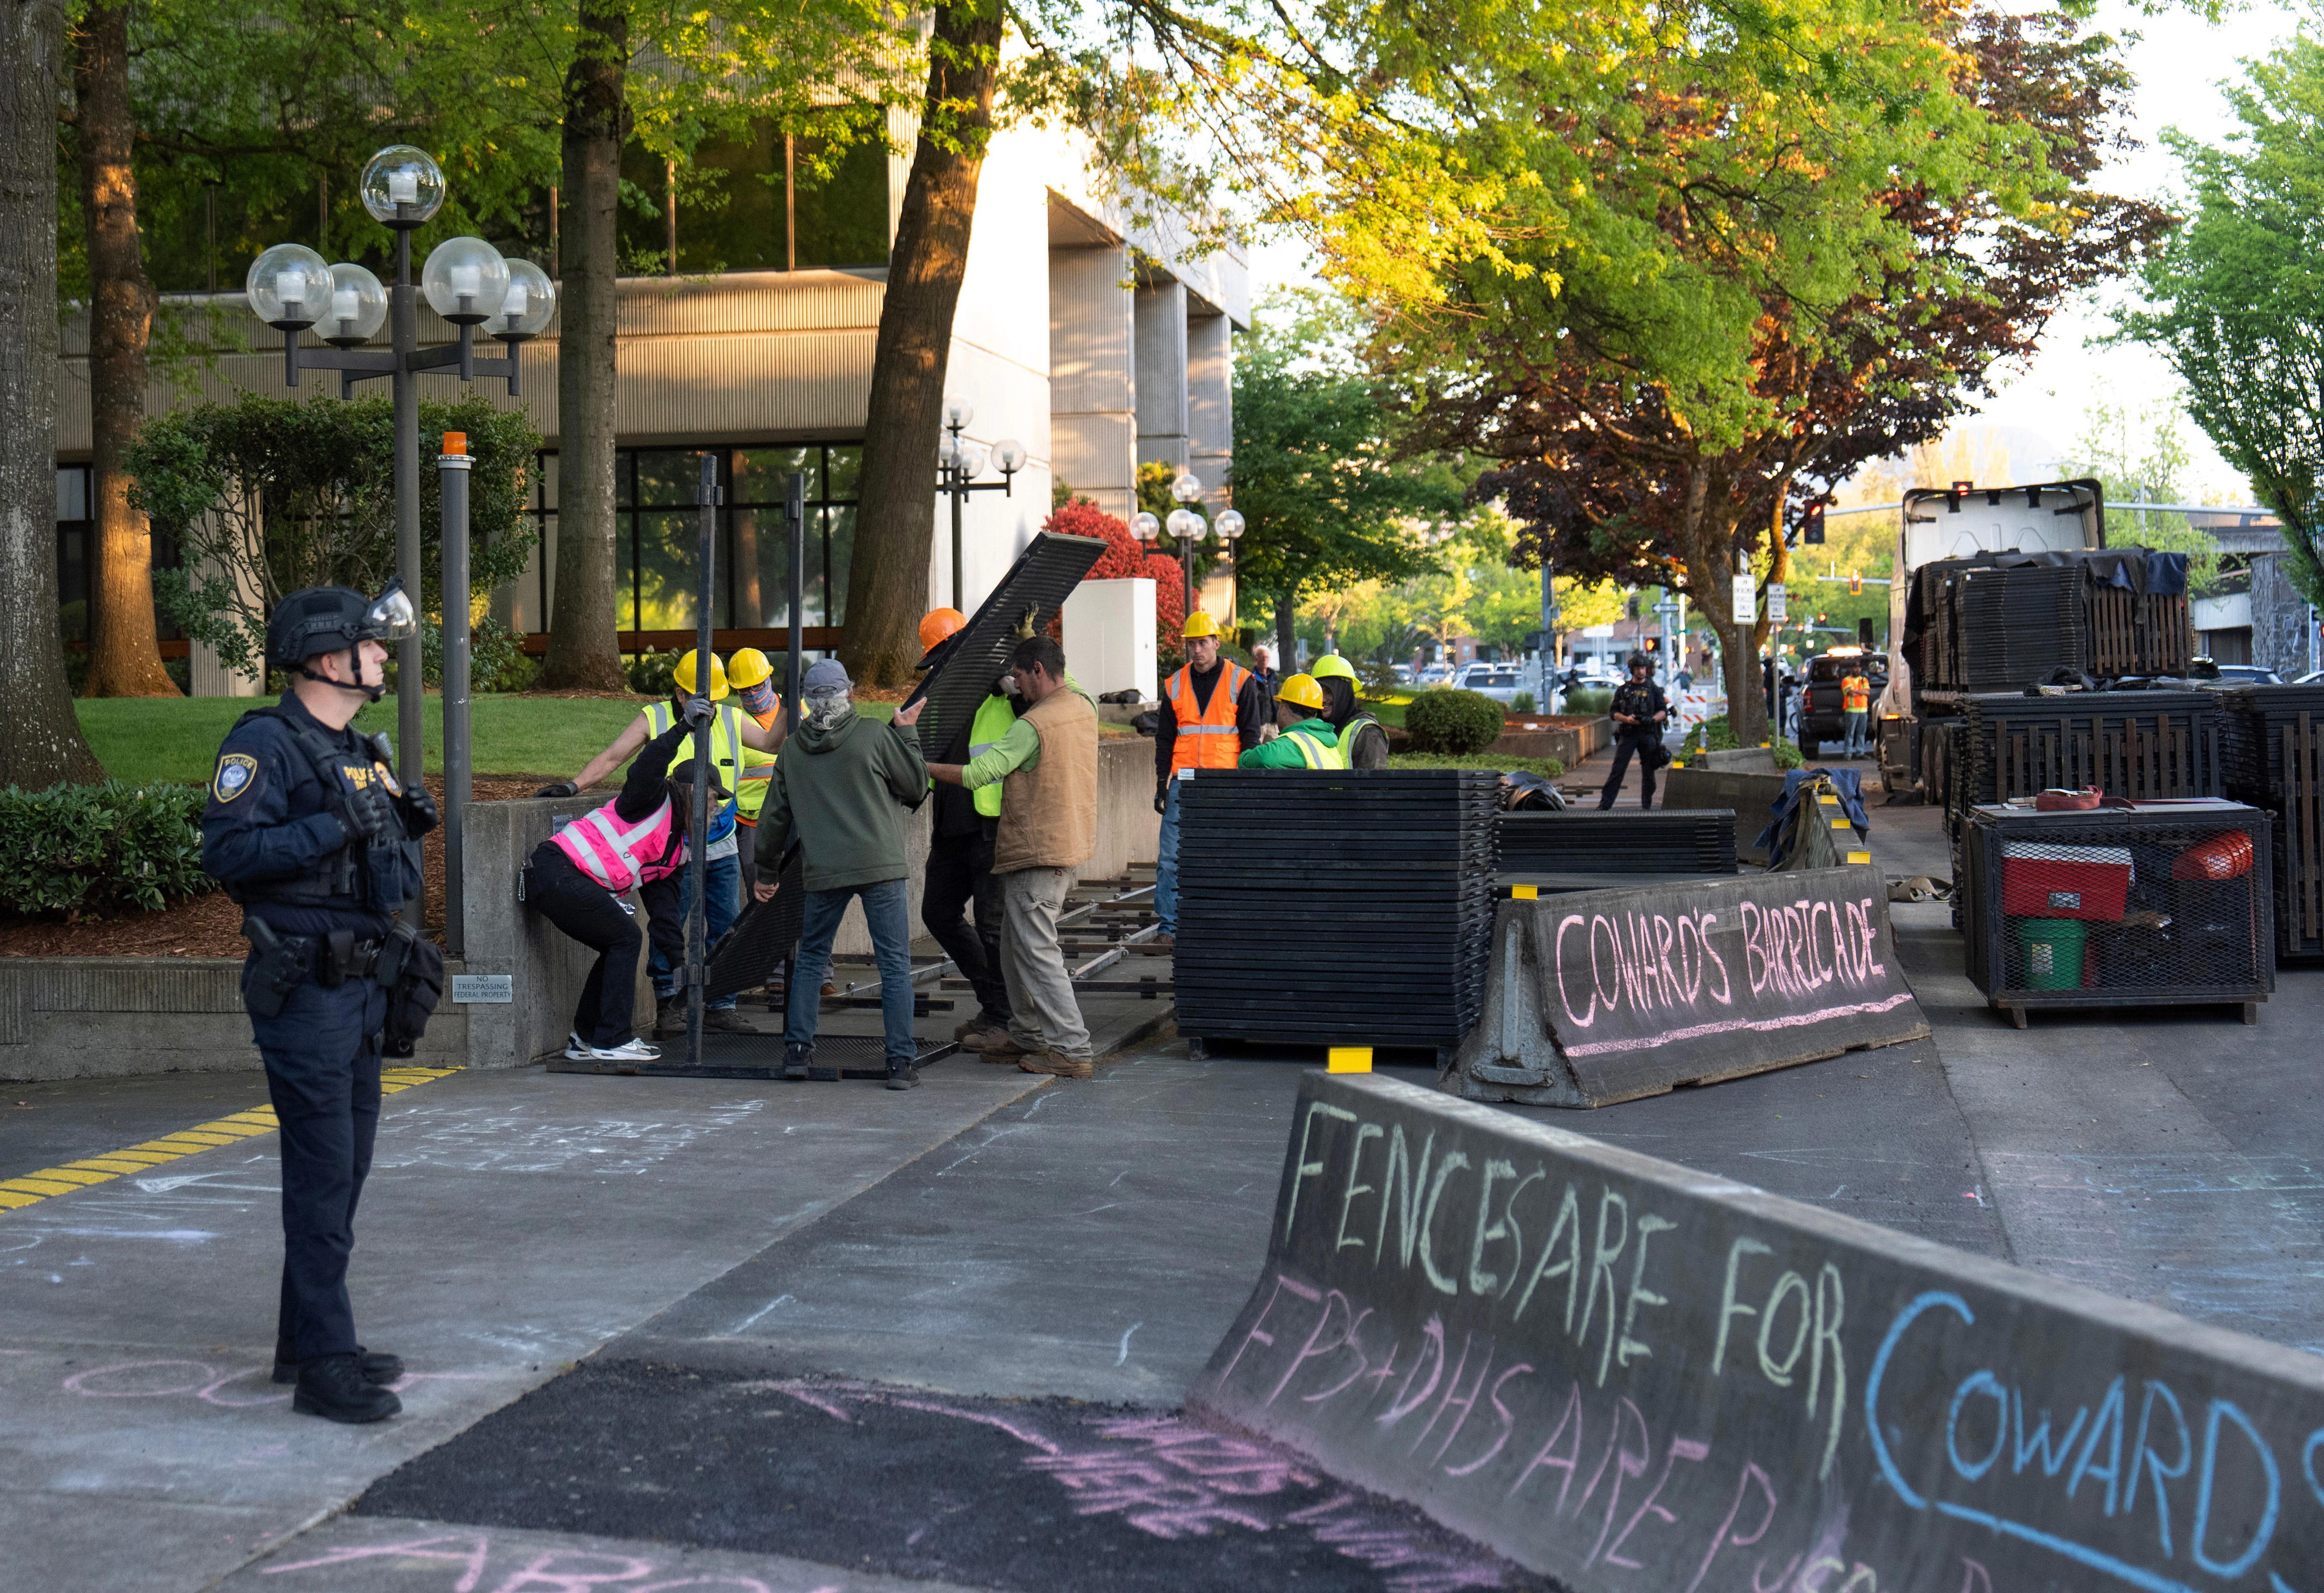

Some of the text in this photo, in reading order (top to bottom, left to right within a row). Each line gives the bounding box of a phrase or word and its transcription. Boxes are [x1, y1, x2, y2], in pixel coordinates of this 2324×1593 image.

[225, 758, 254, 770] POLICE
[1556, 897, 1886, 1027] COWARD'S BARRICADE
[1713, 1226, 1846, 1482] FOR
